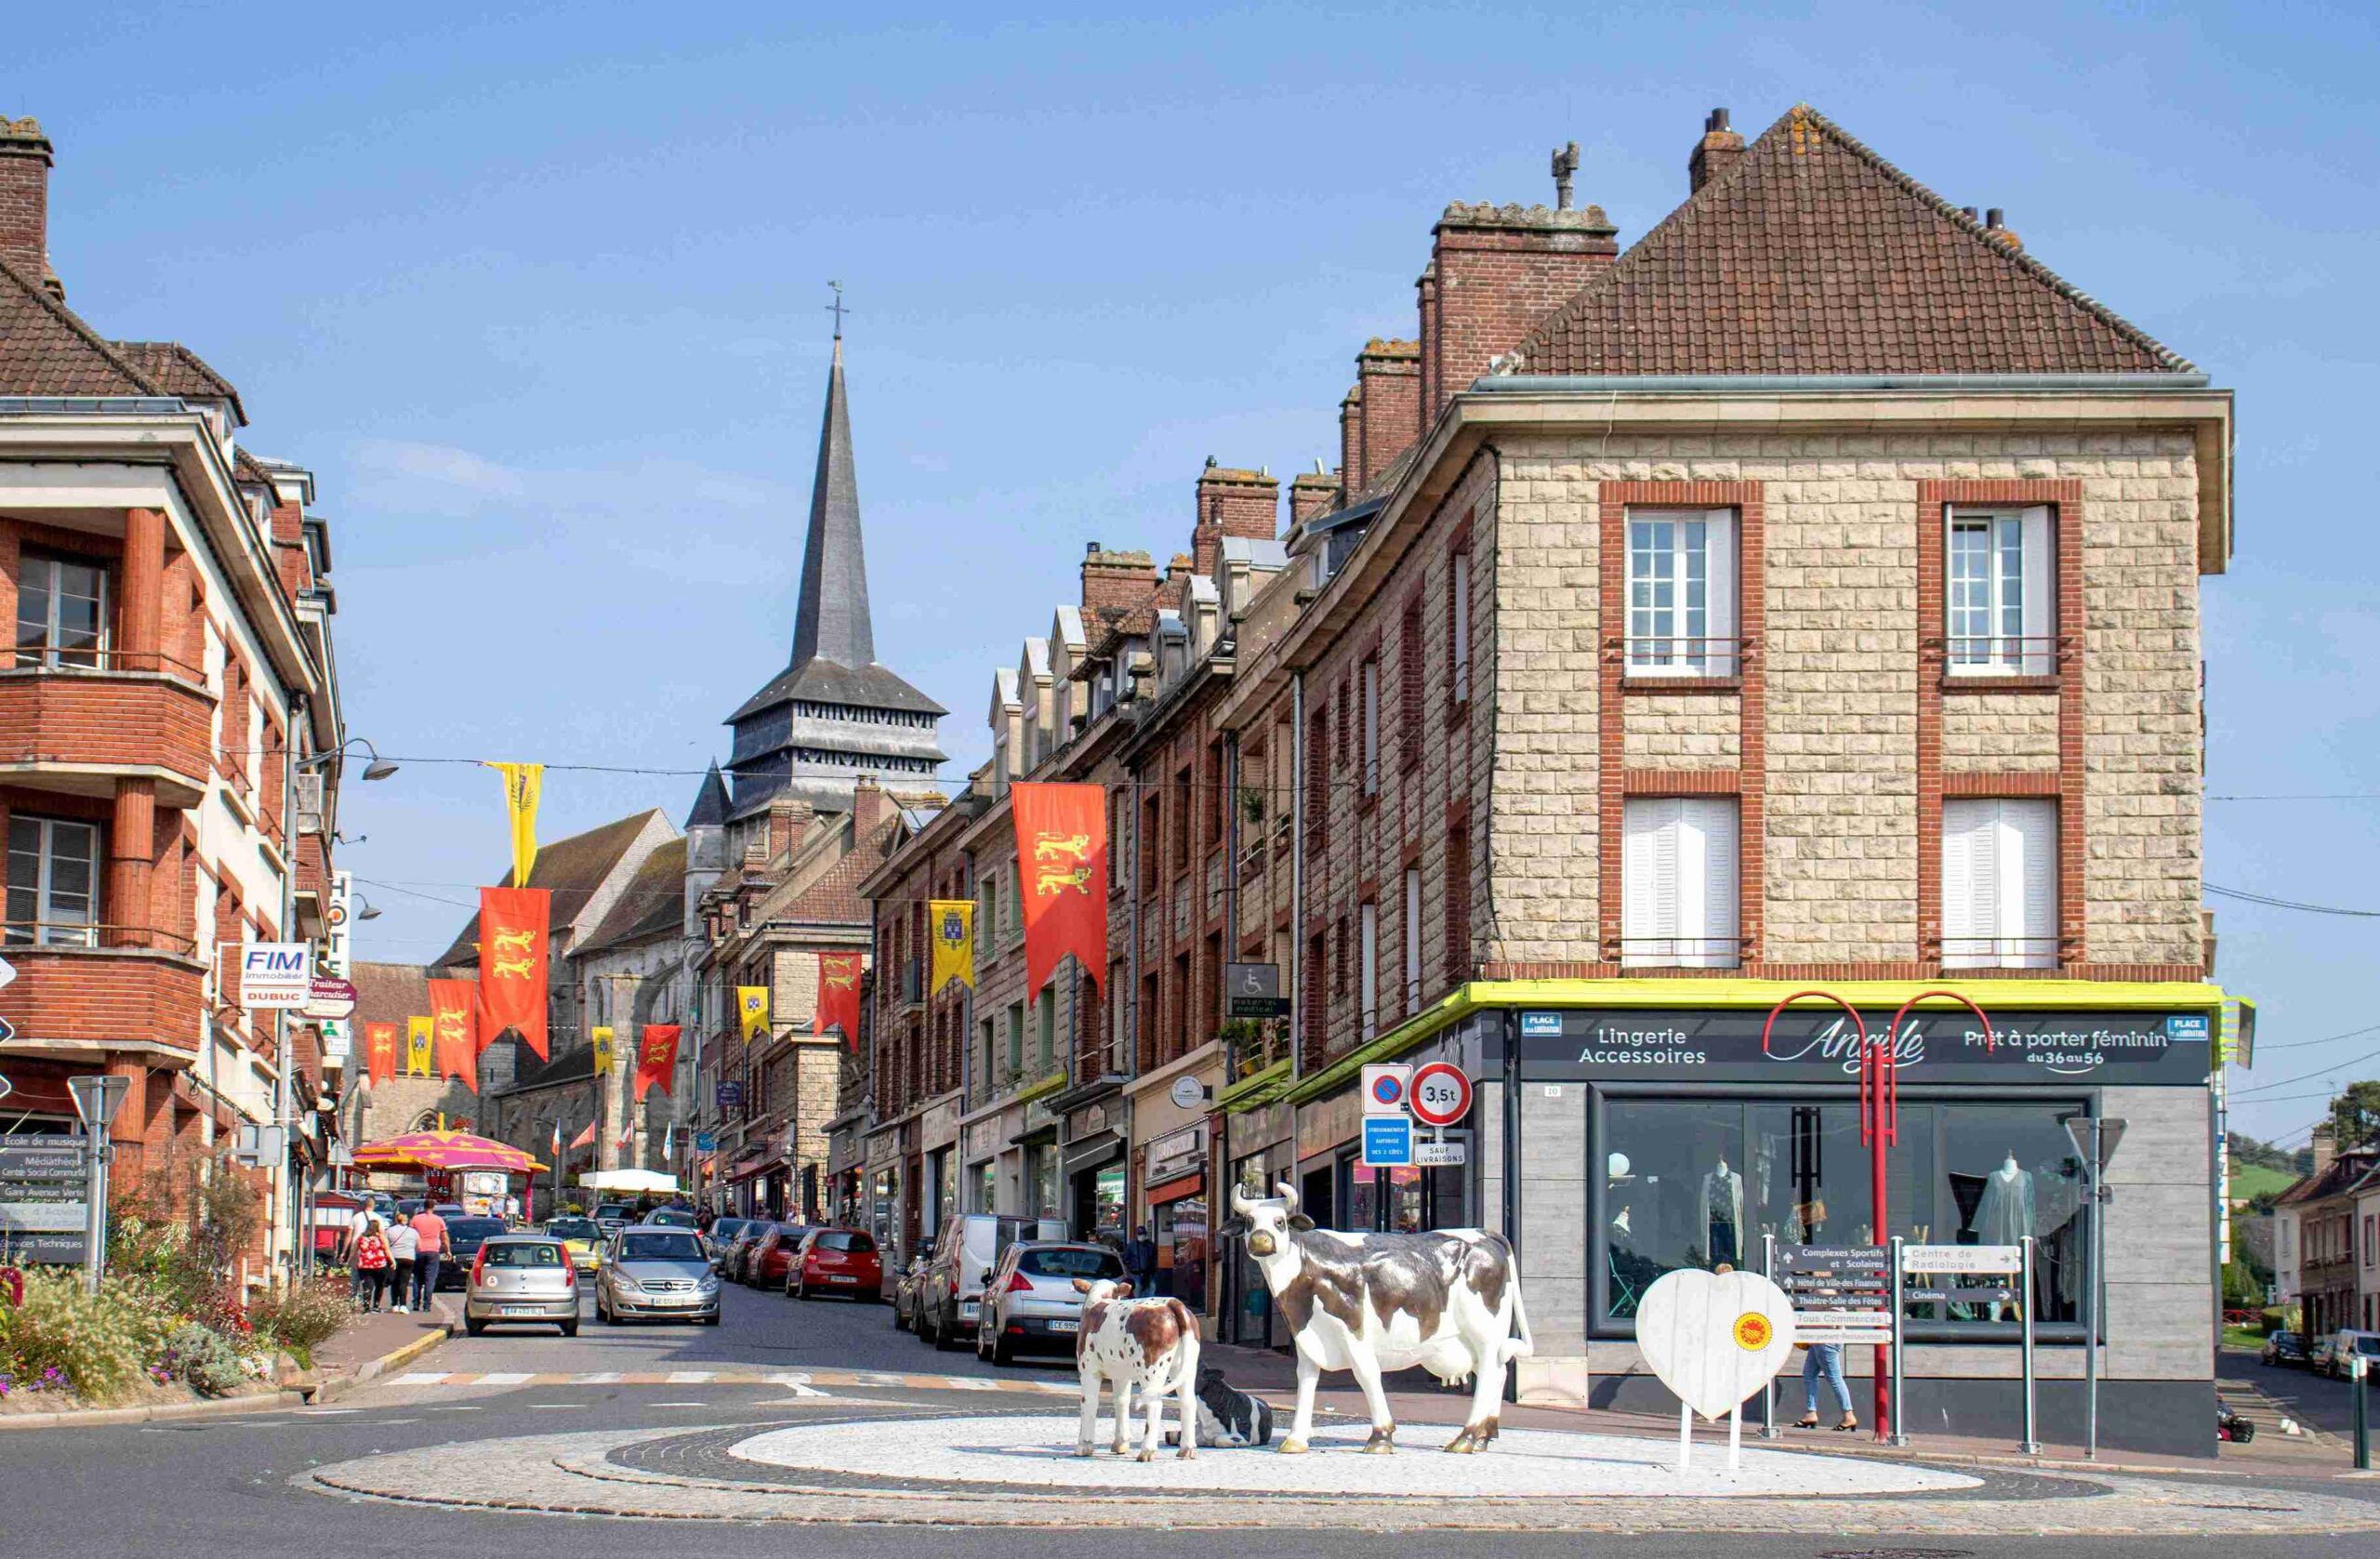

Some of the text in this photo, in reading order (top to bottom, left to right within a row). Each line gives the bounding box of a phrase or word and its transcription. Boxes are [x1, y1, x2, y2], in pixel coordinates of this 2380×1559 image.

[331, 877, 348, 977] HÔTE
[245, 951, 304, 971] FIM
[309, 978, 348, 989] Traiteur
[247, 993, 301, 1001] DUBUC
[308, 988, 350, 999] harcutier
[1529, 1015, 1555, 1024] PLACE
[2175, 1019, 2202, 1028] PLACE
[1598, 1028, 1686, 1047] Lingerie
[2008, 1029, 2022, 1047] à
[2027, 1033, 2087, 1050] porter
[2091, 1029, 2168, 1050] féminin
[1579, 1048, 1707, 1064] Accessoires
[32, 1136, 45, 1146] de
[47, 1137, 87, 1148] musique
[1429, 1146, 1450, 1155] SAUF
[25, 1156, 82, 1168] Médiathèqu
[1416, 1155, 1463, 1163] LIVRAISONS
[27, 1168, 47, 1177] Social
[5, 1187, 86, 1196] Gare Avenue Verte
[37, 1238, 83, 1250] Techniques
[1802, 1249, 1884, 1259] Complexes Sportifs
[1912, 1249, 1972, 1258] Centre de
[1845, 1260, 1884, 1269] Scolaires
[1912, 1260, 1977, 1271] Radiologie
[1797, 1278, 1816, 1287] Hôtel
[1817, 1278, 1825, 1287] de
[1855, 1278, 1883, 1287] Finances
[1912, 1290, 1946, 1299] Cinéma
[1848, 1296, 1861, 1305] des
[1862, 1296, 1883, 1305] Fêtes
[1797, 1314, 1883, 1323] Tous Commerces
[1054, 1321, 1078, 1330] CE-995-
